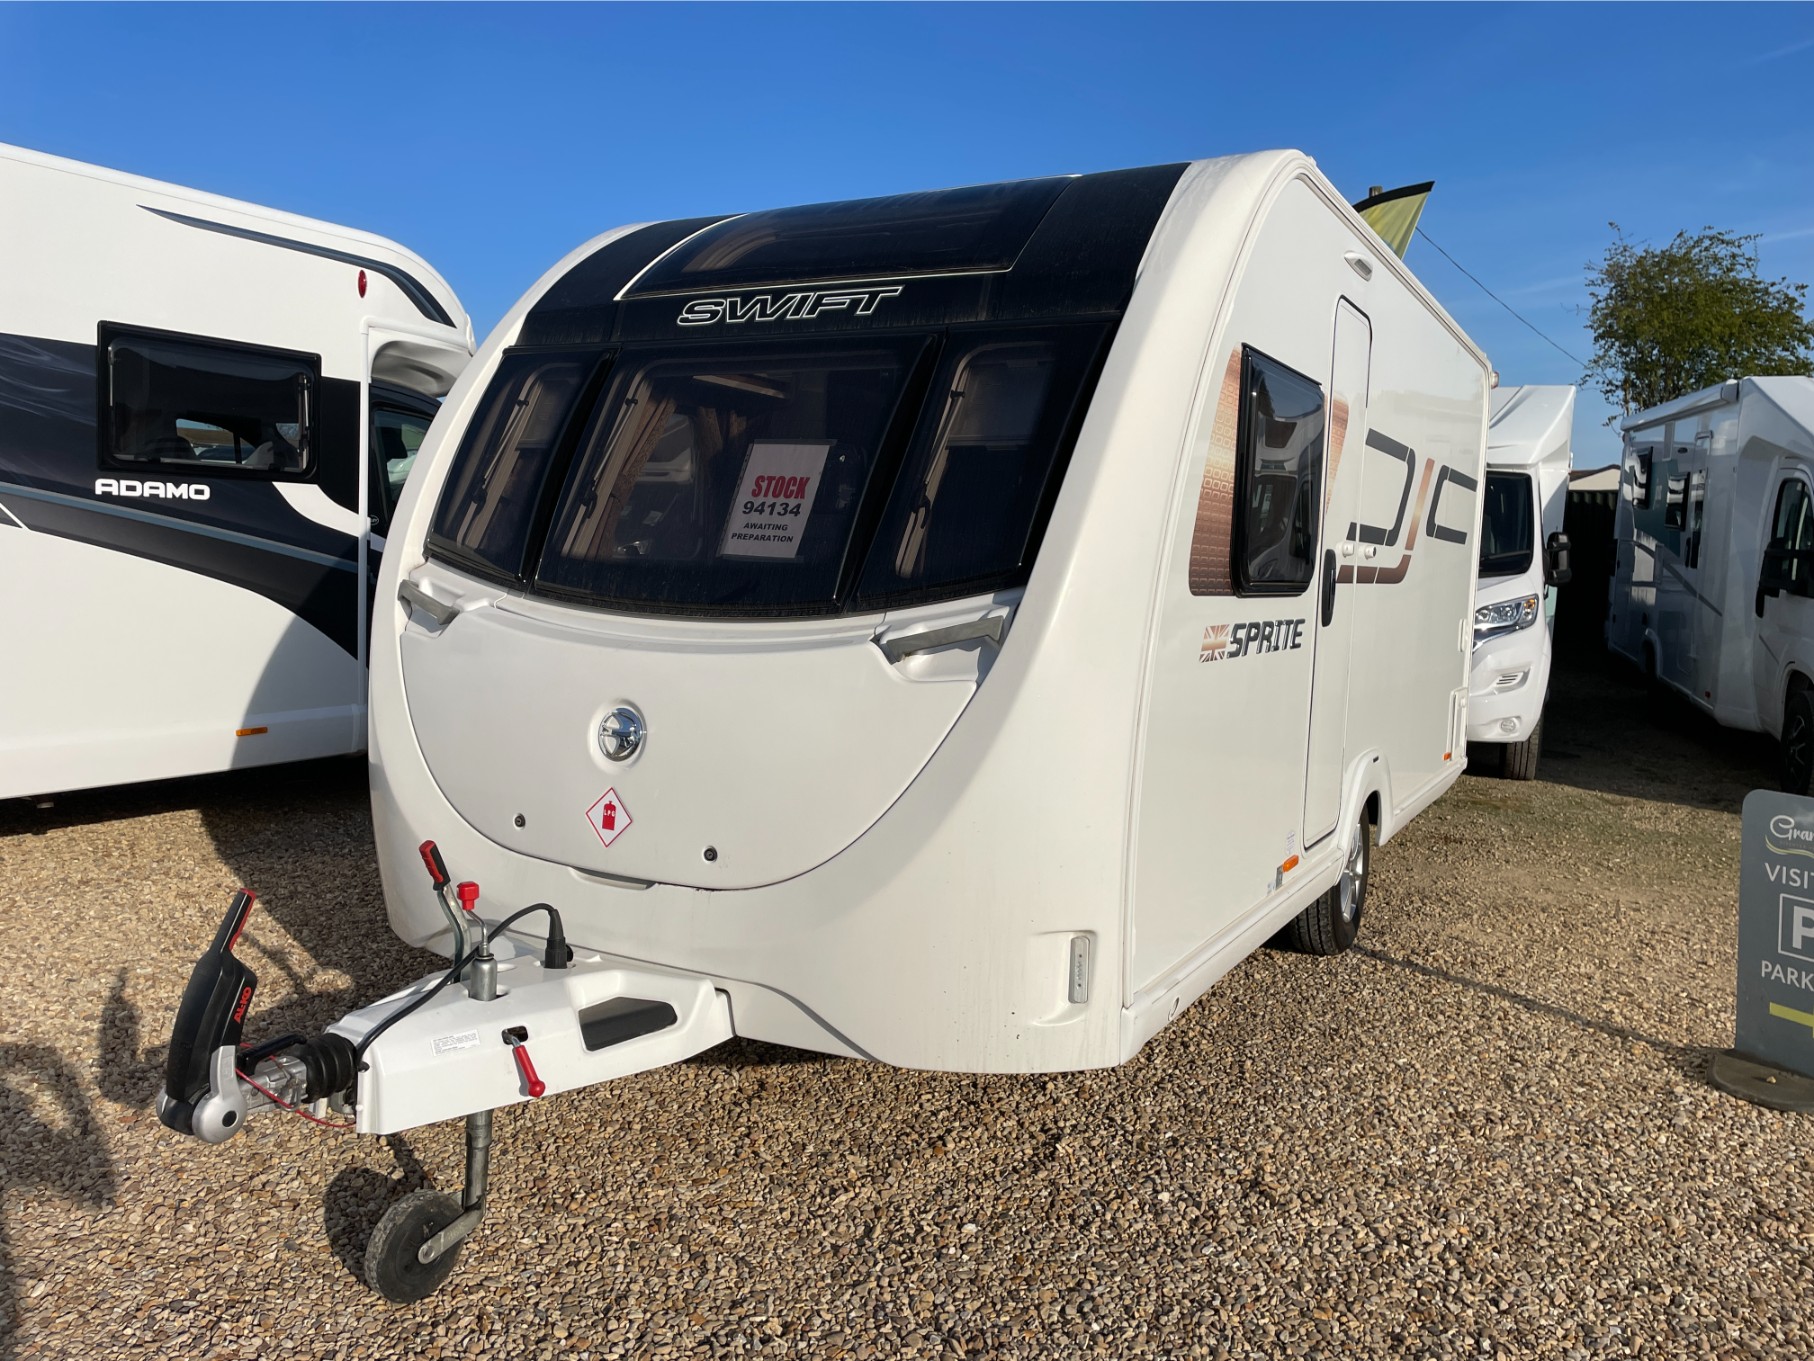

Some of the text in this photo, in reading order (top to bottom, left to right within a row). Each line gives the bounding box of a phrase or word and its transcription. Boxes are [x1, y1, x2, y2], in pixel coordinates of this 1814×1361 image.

[677, 285, 905, 325] SWIFT
[95, 478, 211, 500] ADAMO
[751, 475, 810, 500] STOCK
[742, 500, 802, 517] 94134
[731, 532, 794, 543] PREPARATION
[743, 522, 789, 531] AWAITING
[1227, 618, 1305, 659] SPRITE
[1764, 862, 1814, 889] VISI
[1761, 960, 1814, 992] PARK
